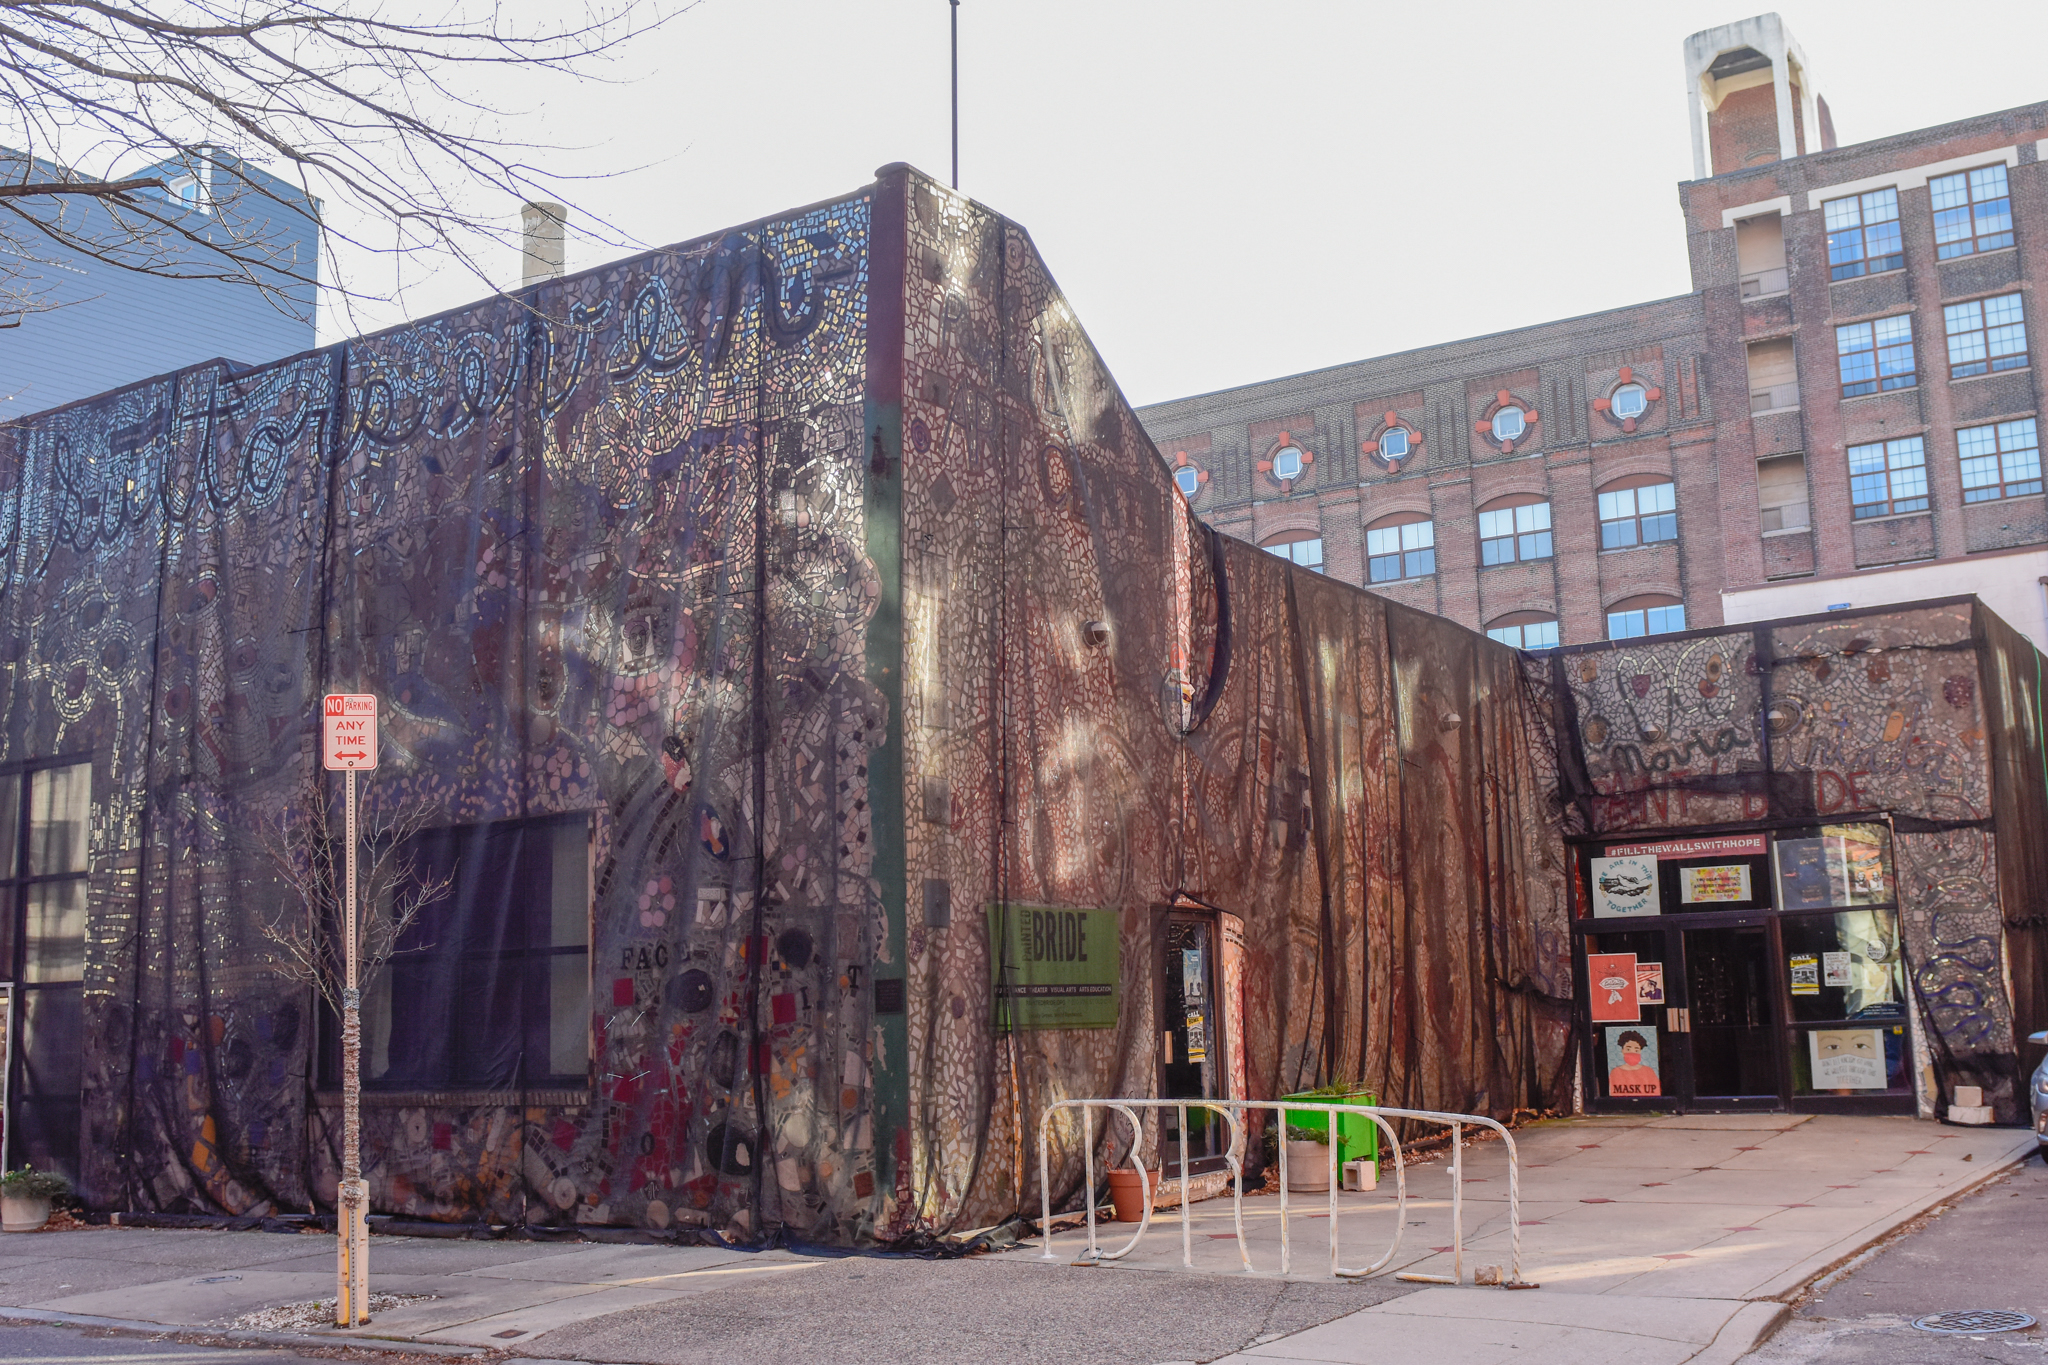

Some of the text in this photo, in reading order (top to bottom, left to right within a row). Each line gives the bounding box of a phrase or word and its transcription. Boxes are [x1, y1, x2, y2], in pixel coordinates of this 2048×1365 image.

[327, 699, 373, 713] NO PARKING
[336, 721, 365, 731] ANY
[335, 735, 366, 745] TIME
[1610, 838, 1761, 856] #FILLTHEWALLSWITHHOPE
[1599, 871, 1609, 884] WE
[1608, 859, 1624, 870] ARE
[1628, 859, 1638, 867] IN
[1606, 897, 1648, 914] TOGETHER
[1020, 910, 1088, 962] PAINTED BRIDE
[1612, 1083, 1657, 1094] MASK UP
